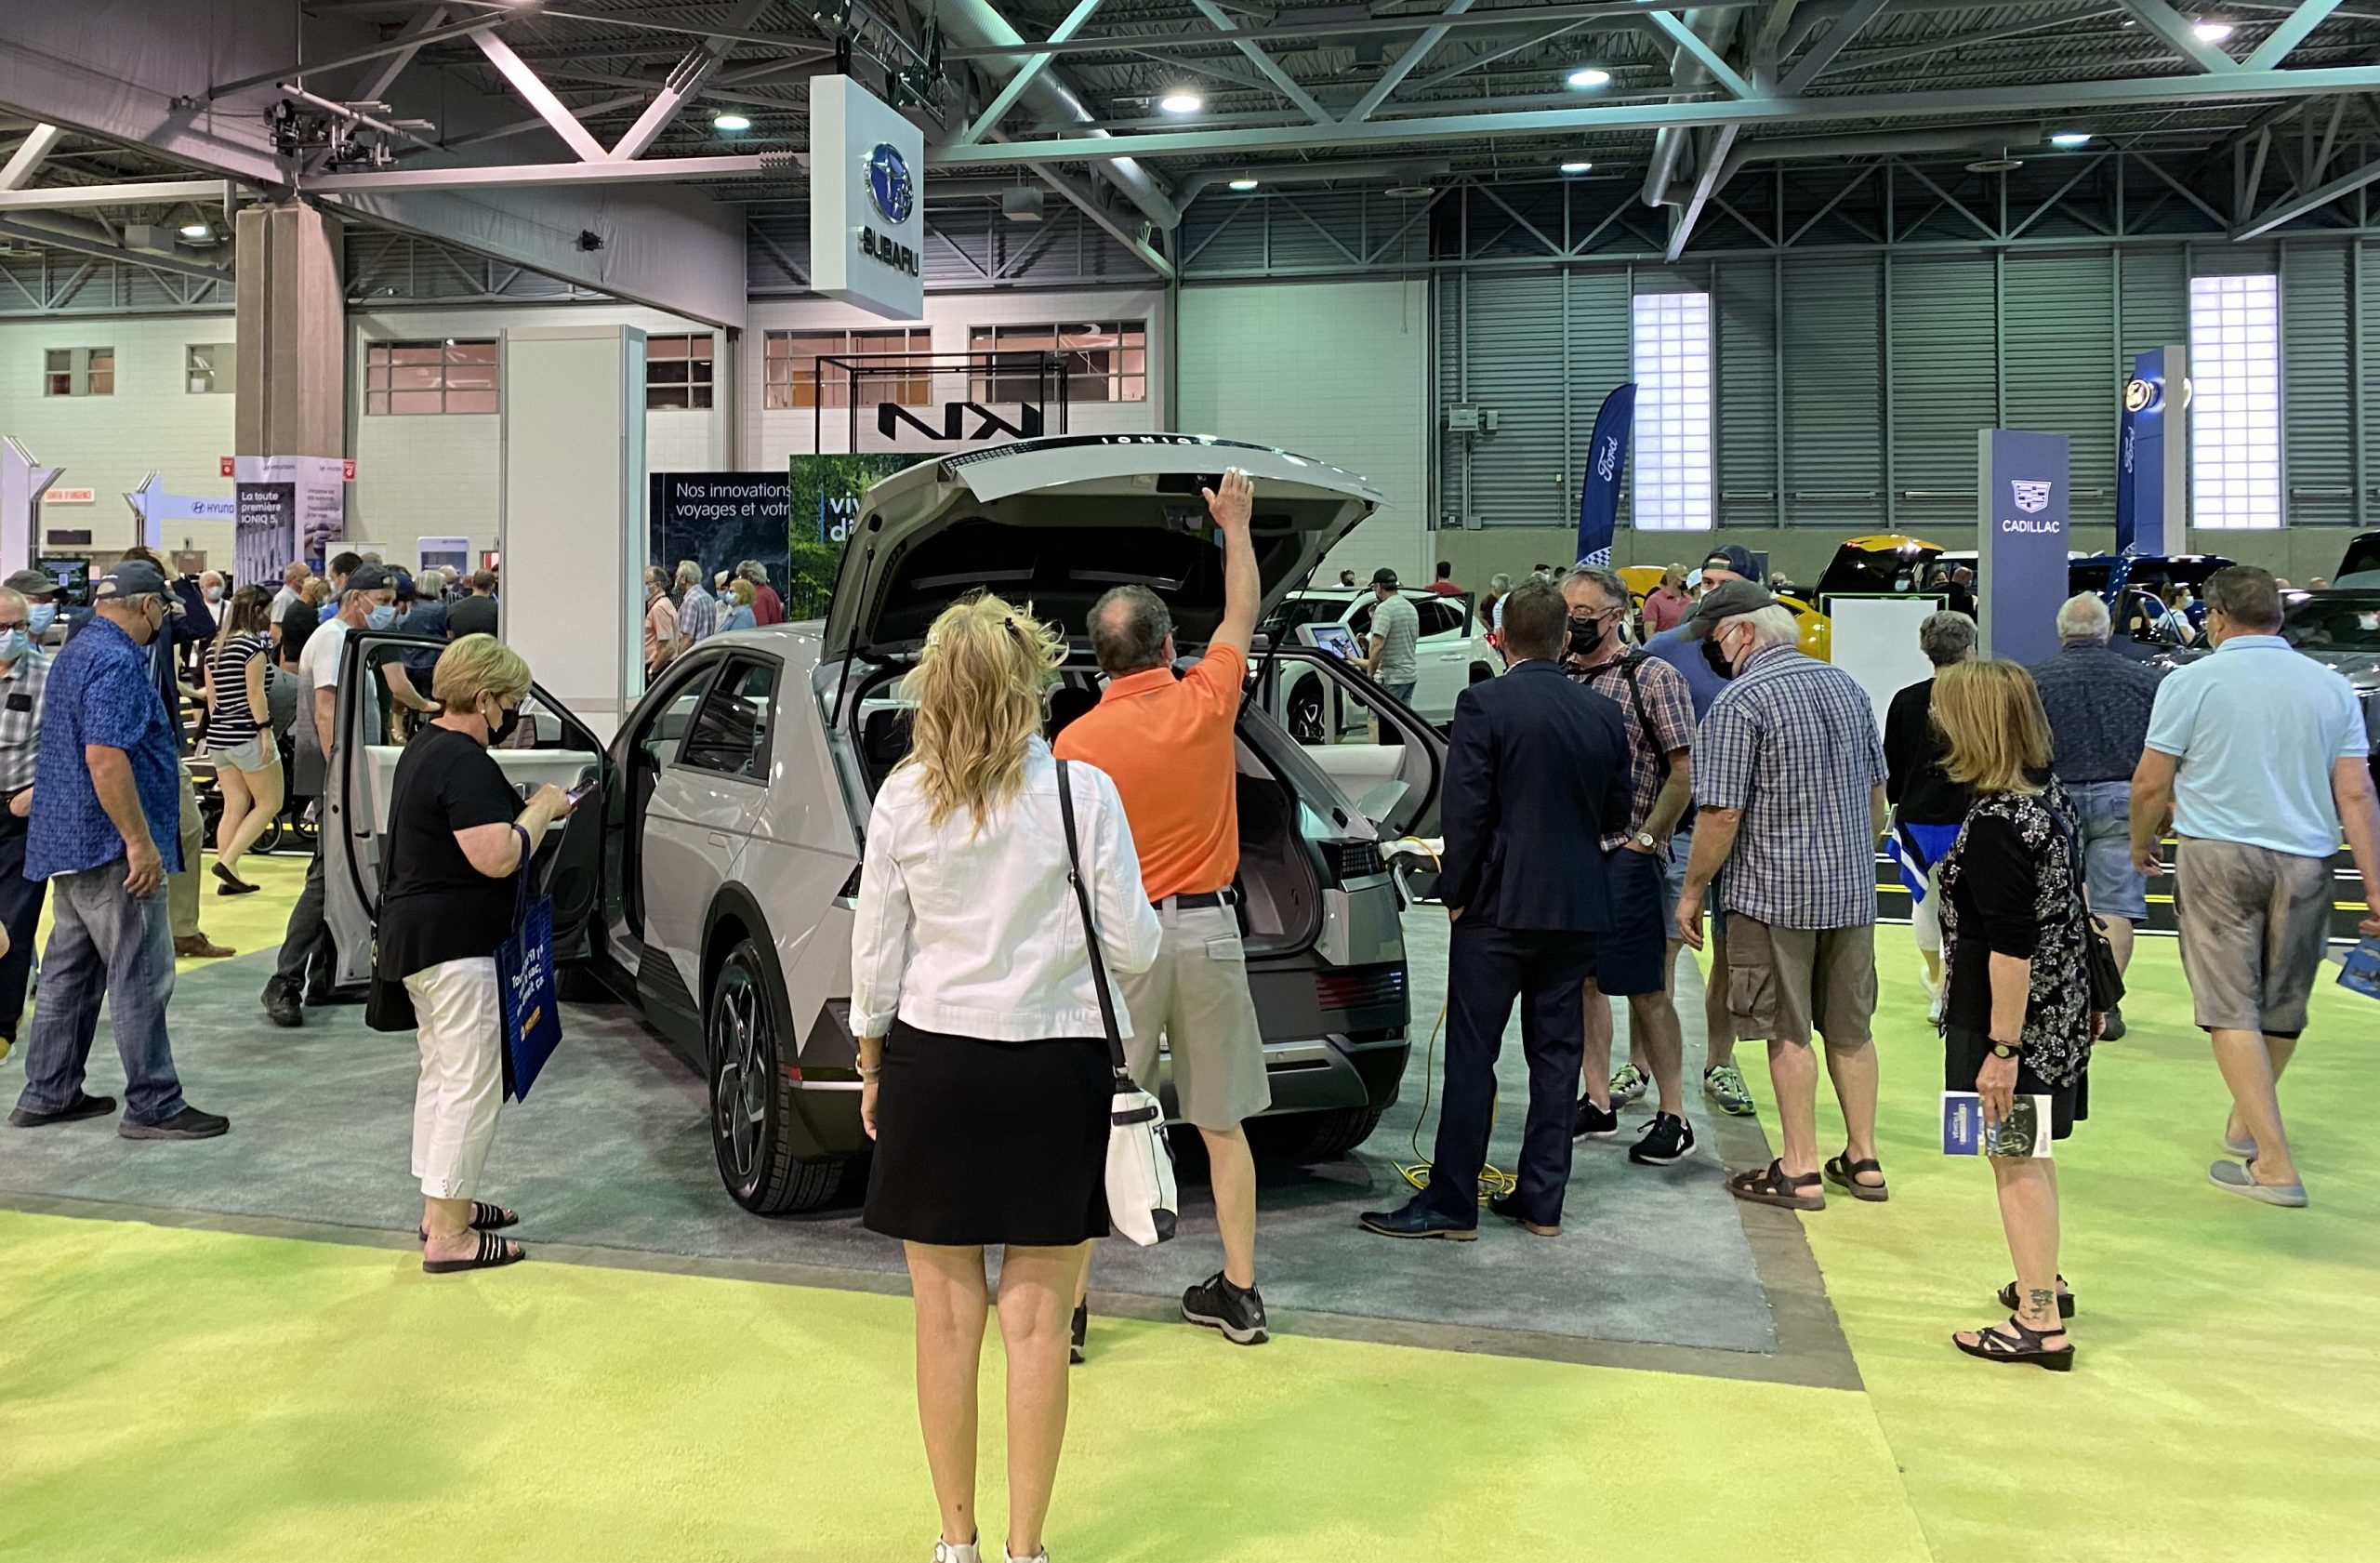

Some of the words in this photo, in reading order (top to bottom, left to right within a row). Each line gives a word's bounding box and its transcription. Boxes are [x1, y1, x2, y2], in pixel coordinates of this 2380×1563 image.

[863, 225, 919, 278] SUBARU
[1102, 436, 1192, 444] IONIQ
[1598, 436, 1618, 482] Ford
[242, 491, 253, 501] La
[254, 491, 279, 501] toute
[677, 483, 705, 497] Nos
[242, 501, 281, 512] première
[676, 504, 736, 520] voyages
[741, 502, 756, 516] et
[242, 514, 268, 524] IONIQ
[2002, 519, 2060, 534] CADILLAC
